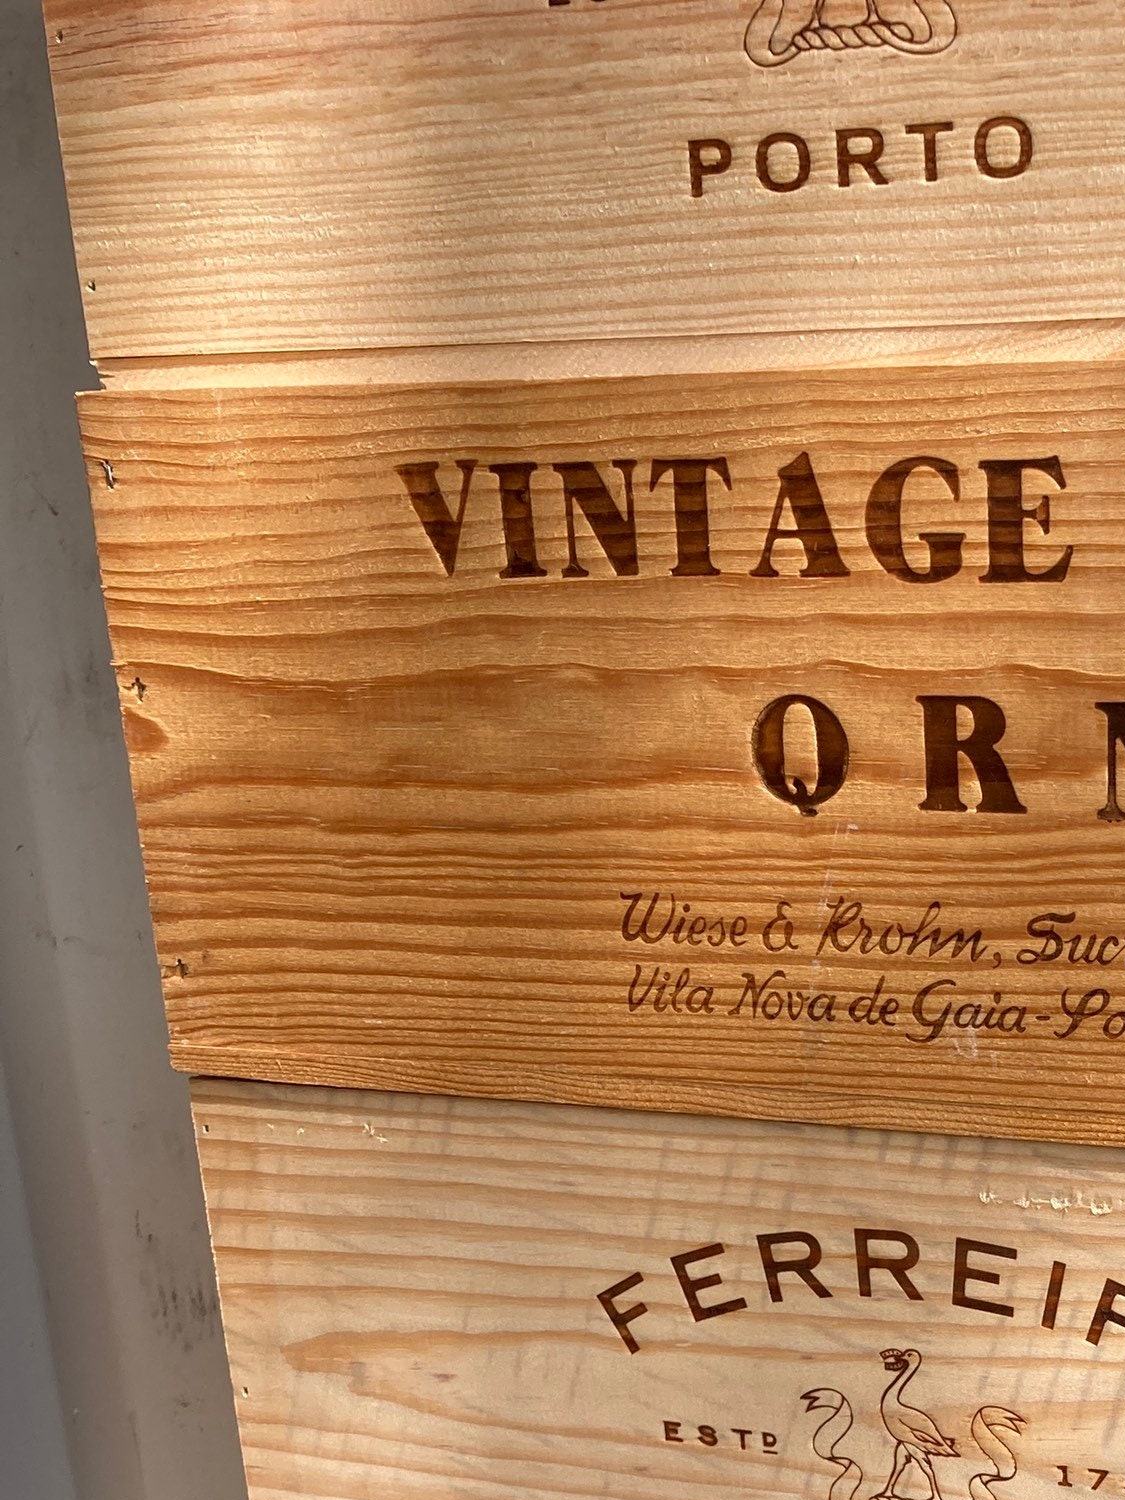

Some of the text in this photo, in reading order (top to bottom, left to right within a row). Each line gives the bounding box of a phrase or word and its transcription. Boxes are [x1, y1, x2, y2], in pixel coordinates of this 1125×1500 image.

[687, 115, 1033, 198] PORTO
[394, 451, 1074, 583] VINTAGE
[619, 892, 748, 947] Wiese
[762, 901, 799, 952] &
[628, 964, 714, 1014] Vila
[729, 970, 837, 1020] Nova
[848, 975, 900, 1026] de
[662, 1420, 779, 1455] ESTD
